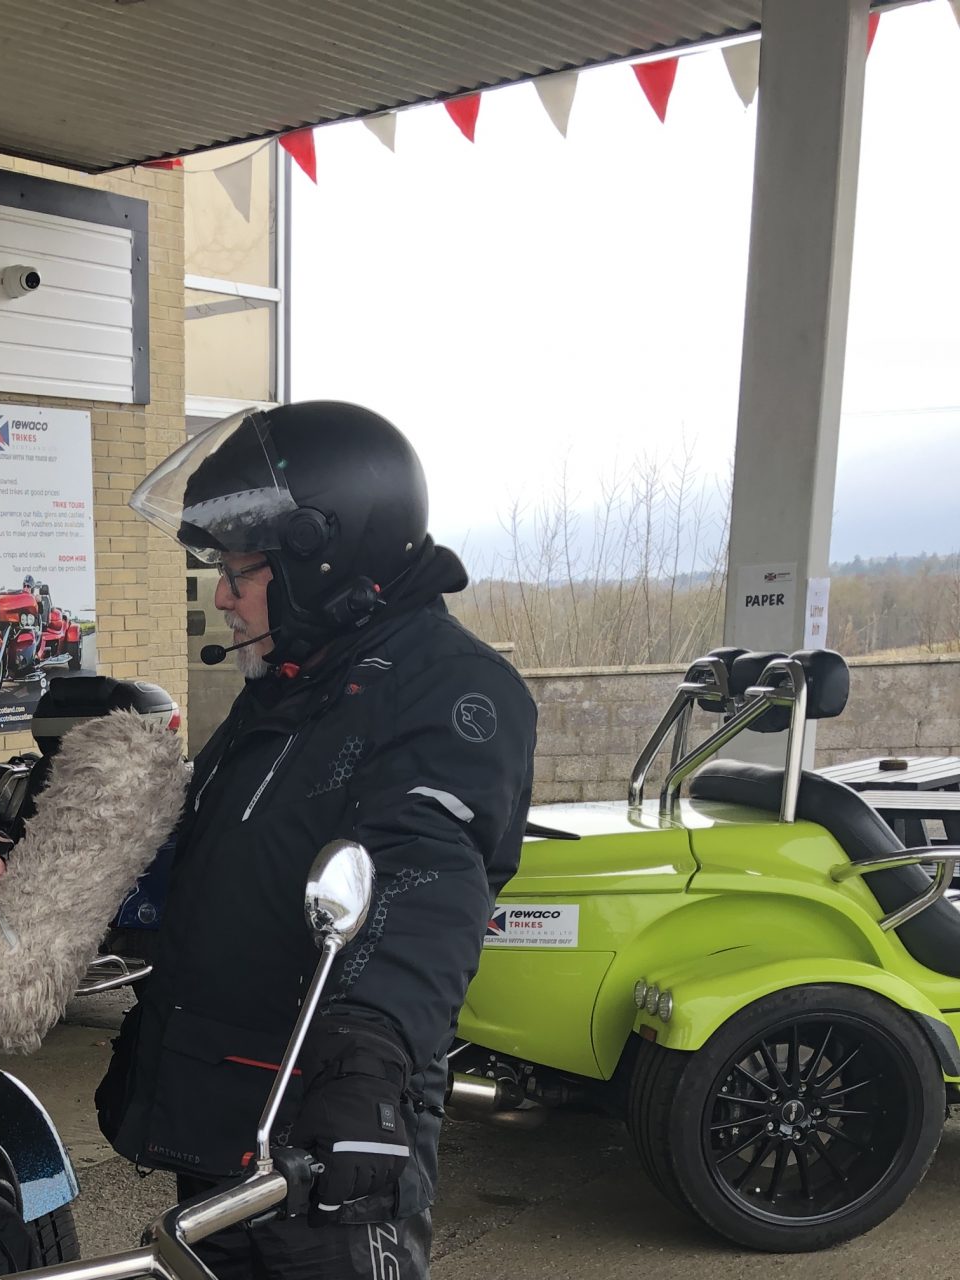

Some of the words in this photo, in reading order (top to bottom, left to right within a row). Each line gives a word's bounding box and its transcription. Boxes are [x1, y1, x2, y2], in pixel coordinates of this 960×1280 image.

[12, 420, 48, 432] rewaco
[12, 433, 37, 443] TRIKES
[9, 488, 23, 496] trikes
[31, 489, 44, 498] good
[20, 520, 30, 528] Gift
[745, 593, 784, 607] PAPER
[509, 910, 561, 919] rewaco
[148, 1142, 200, 1164] LAMINATED
